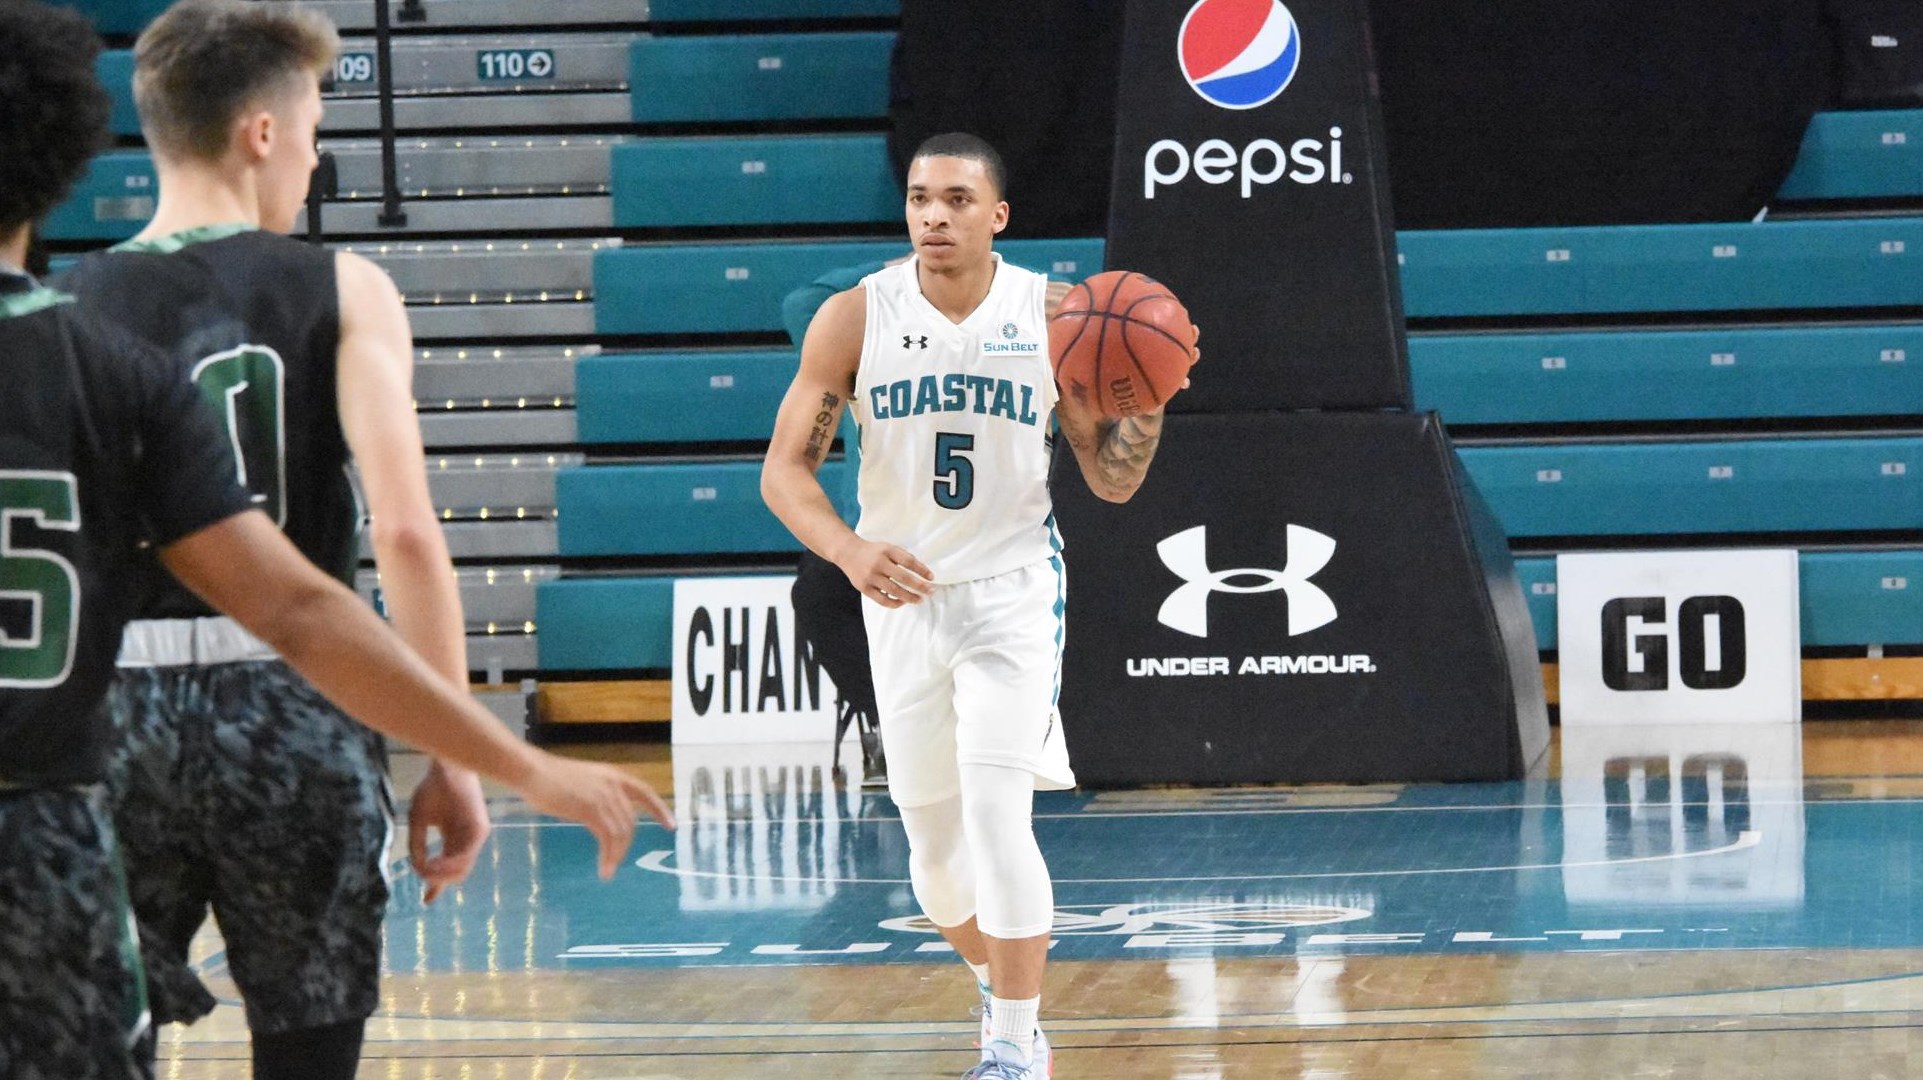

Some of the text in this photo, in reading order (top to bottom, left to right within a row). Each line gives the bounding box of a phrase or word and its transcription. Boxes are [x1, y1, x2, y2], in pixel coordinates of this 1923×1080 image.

[481, 52, 524, 77] 110
[1144, 126, 1342, 199] pepsi
[870, 373, 1037, 426] COASTAL
[933, 432, 974, 510] 5
[1126, 655, 1371, 676] UNDER ARMOUR
[1601, 595, 1746, 691] GO
[1123, 929, 1665, 948] BELT
